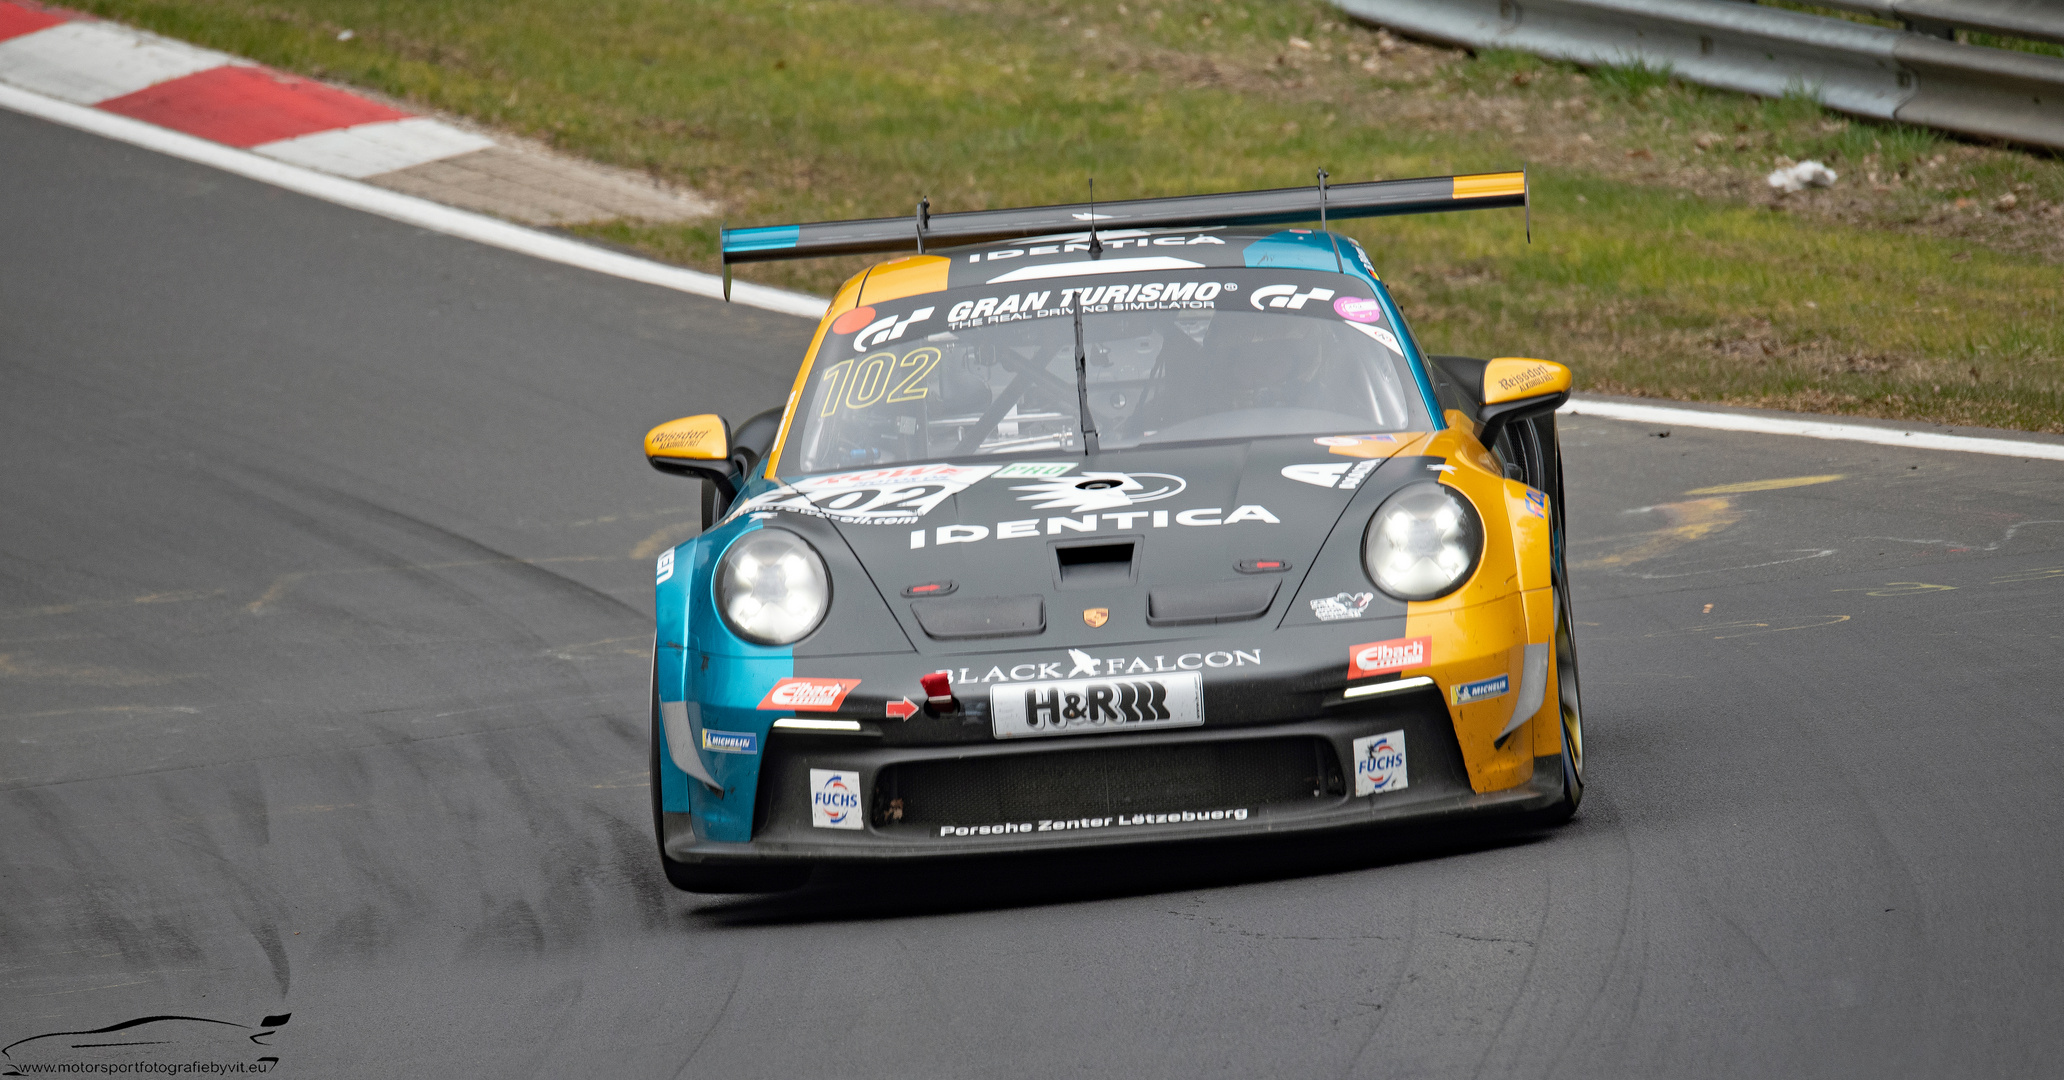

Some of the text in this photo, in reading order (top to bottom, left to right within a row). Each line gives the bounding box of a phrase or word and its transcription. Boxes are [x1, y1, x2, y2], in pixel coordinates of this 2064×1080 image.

[969, 235, 1226, 263] IDENTICA
[947, 291, 1051, 323] GRAN
[948, 300, 1215, 331] THE REAL DRIVNG SIMULATOR
[820, 346, 942, 418] 102
[910, 504, 1281, 550] IDENTICA
[1106, 648, 1262, 676] FALCON
[1472, 680, 1506, 697] MICHELIN
[1024, 683, 1122, 728] H&R
[712, 736, 750, 748] MICHELIN
[1358, 752, 1403, 775] FUCHS
[815, 791, 857, 808] FUCHS
[940, 822, 1033, 837] Porsche
[1037, 816, 1113, 832] Zenter
